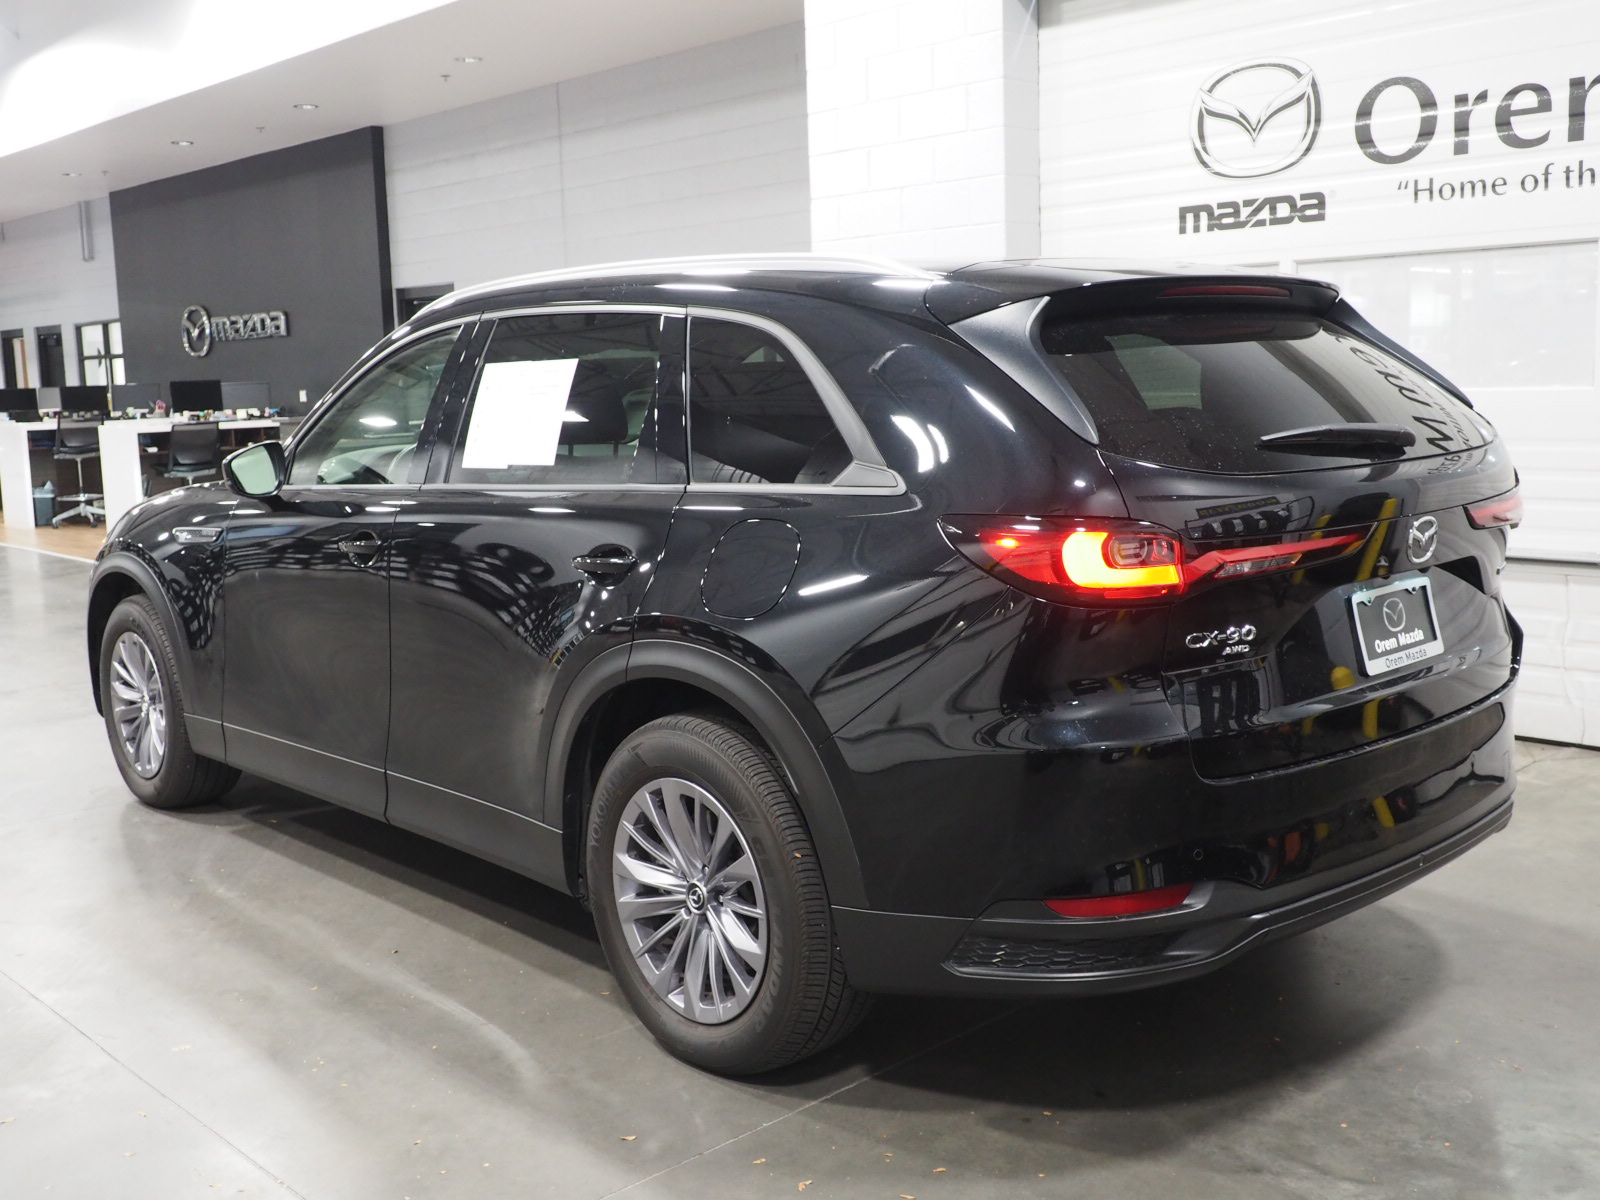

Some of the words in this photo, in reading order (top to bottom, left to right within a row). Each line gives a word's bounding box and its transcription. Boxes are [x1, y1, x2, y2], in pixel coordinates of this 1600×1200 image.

[1520, 162, 1555, 192] of
[1178, 191, 1326, 235] mazda
[1185, 624, 1257, 649] CX-90
[1374, 637, 1399, 653] Orem
[1397, 627, 1425, 646] Mazda
[1222, 644, 1251, 656] AWD
[1384, 656, 1405, 668] Orem
[1404, 649, 1428, 662] Mazda
